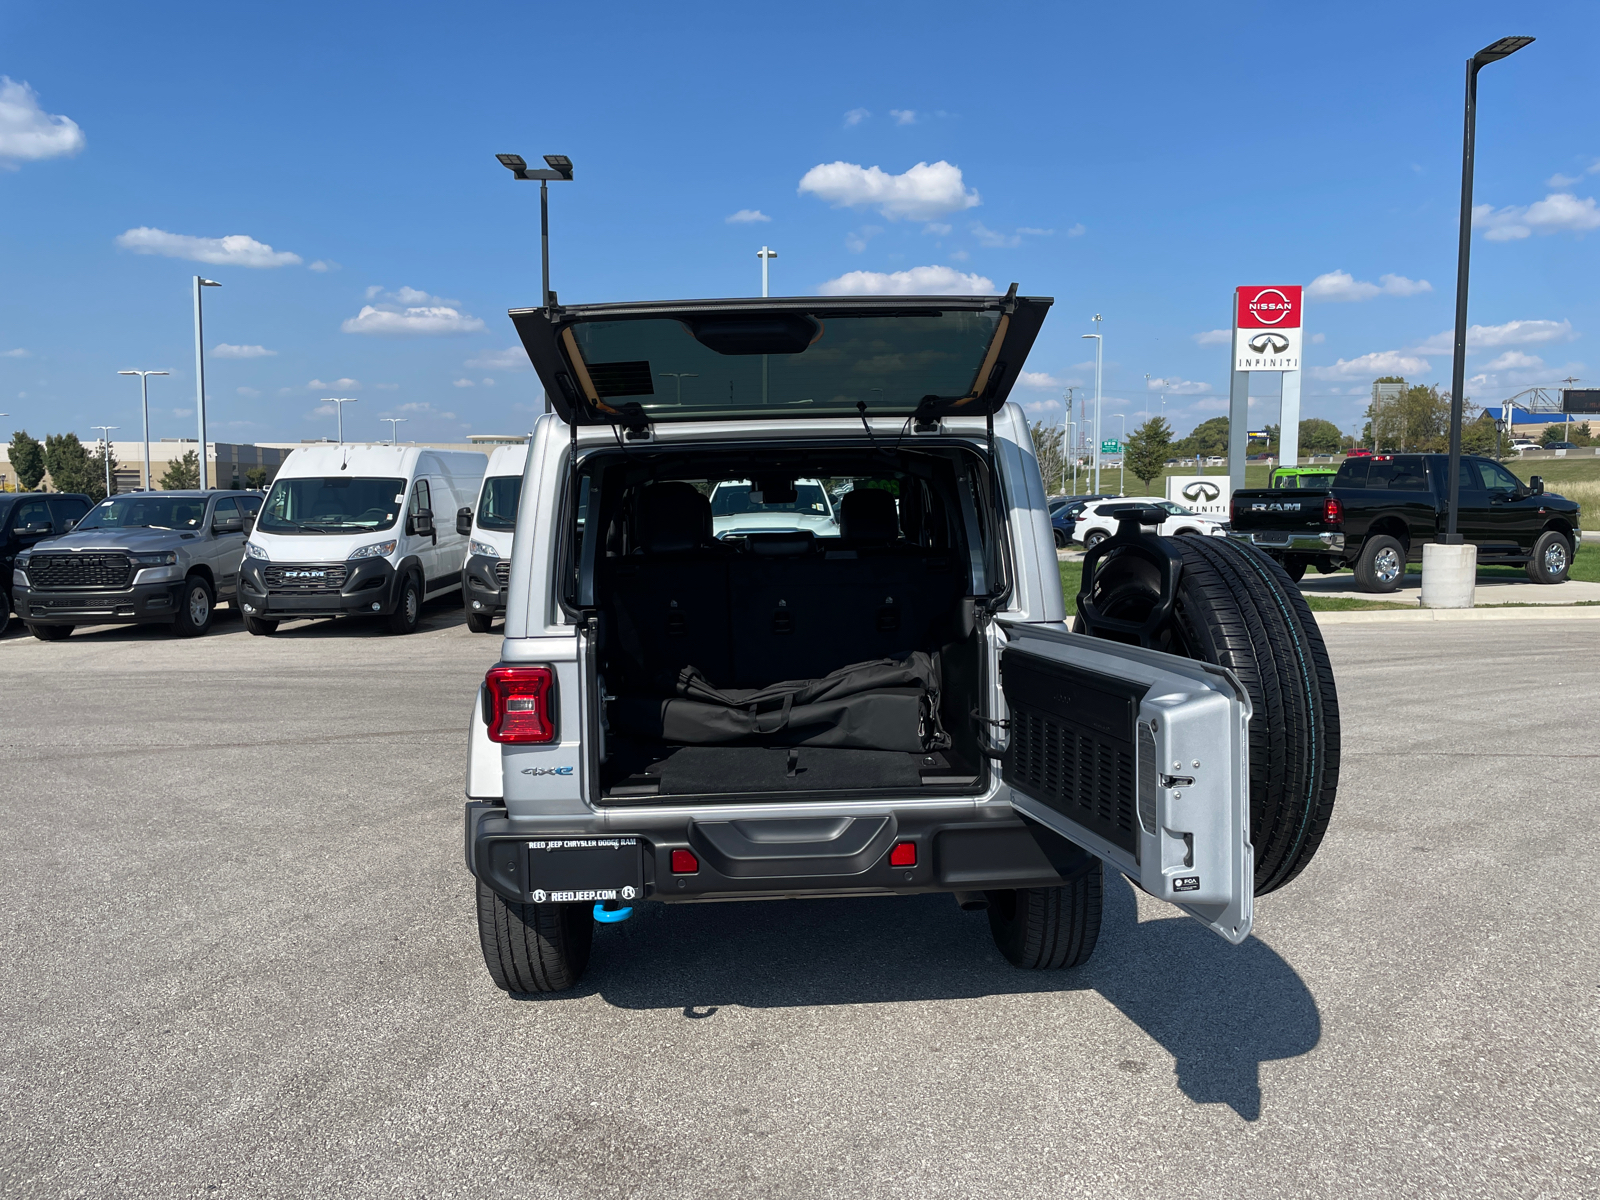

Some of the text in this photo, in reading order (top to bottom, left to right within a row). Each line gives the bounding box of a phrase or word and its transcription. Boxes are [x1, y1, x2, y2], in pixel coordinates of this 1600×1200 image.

[1239, 358, 1297, 367] INFINITI
[1251, 503, 1301, 511] RAM
[51, 559, 100, 567] RAM
[529, 838, 637, 849] REED JEEP CHRYSLER DODGE RAM
[551, 890, 617, 902] REEDJEEP.COM
